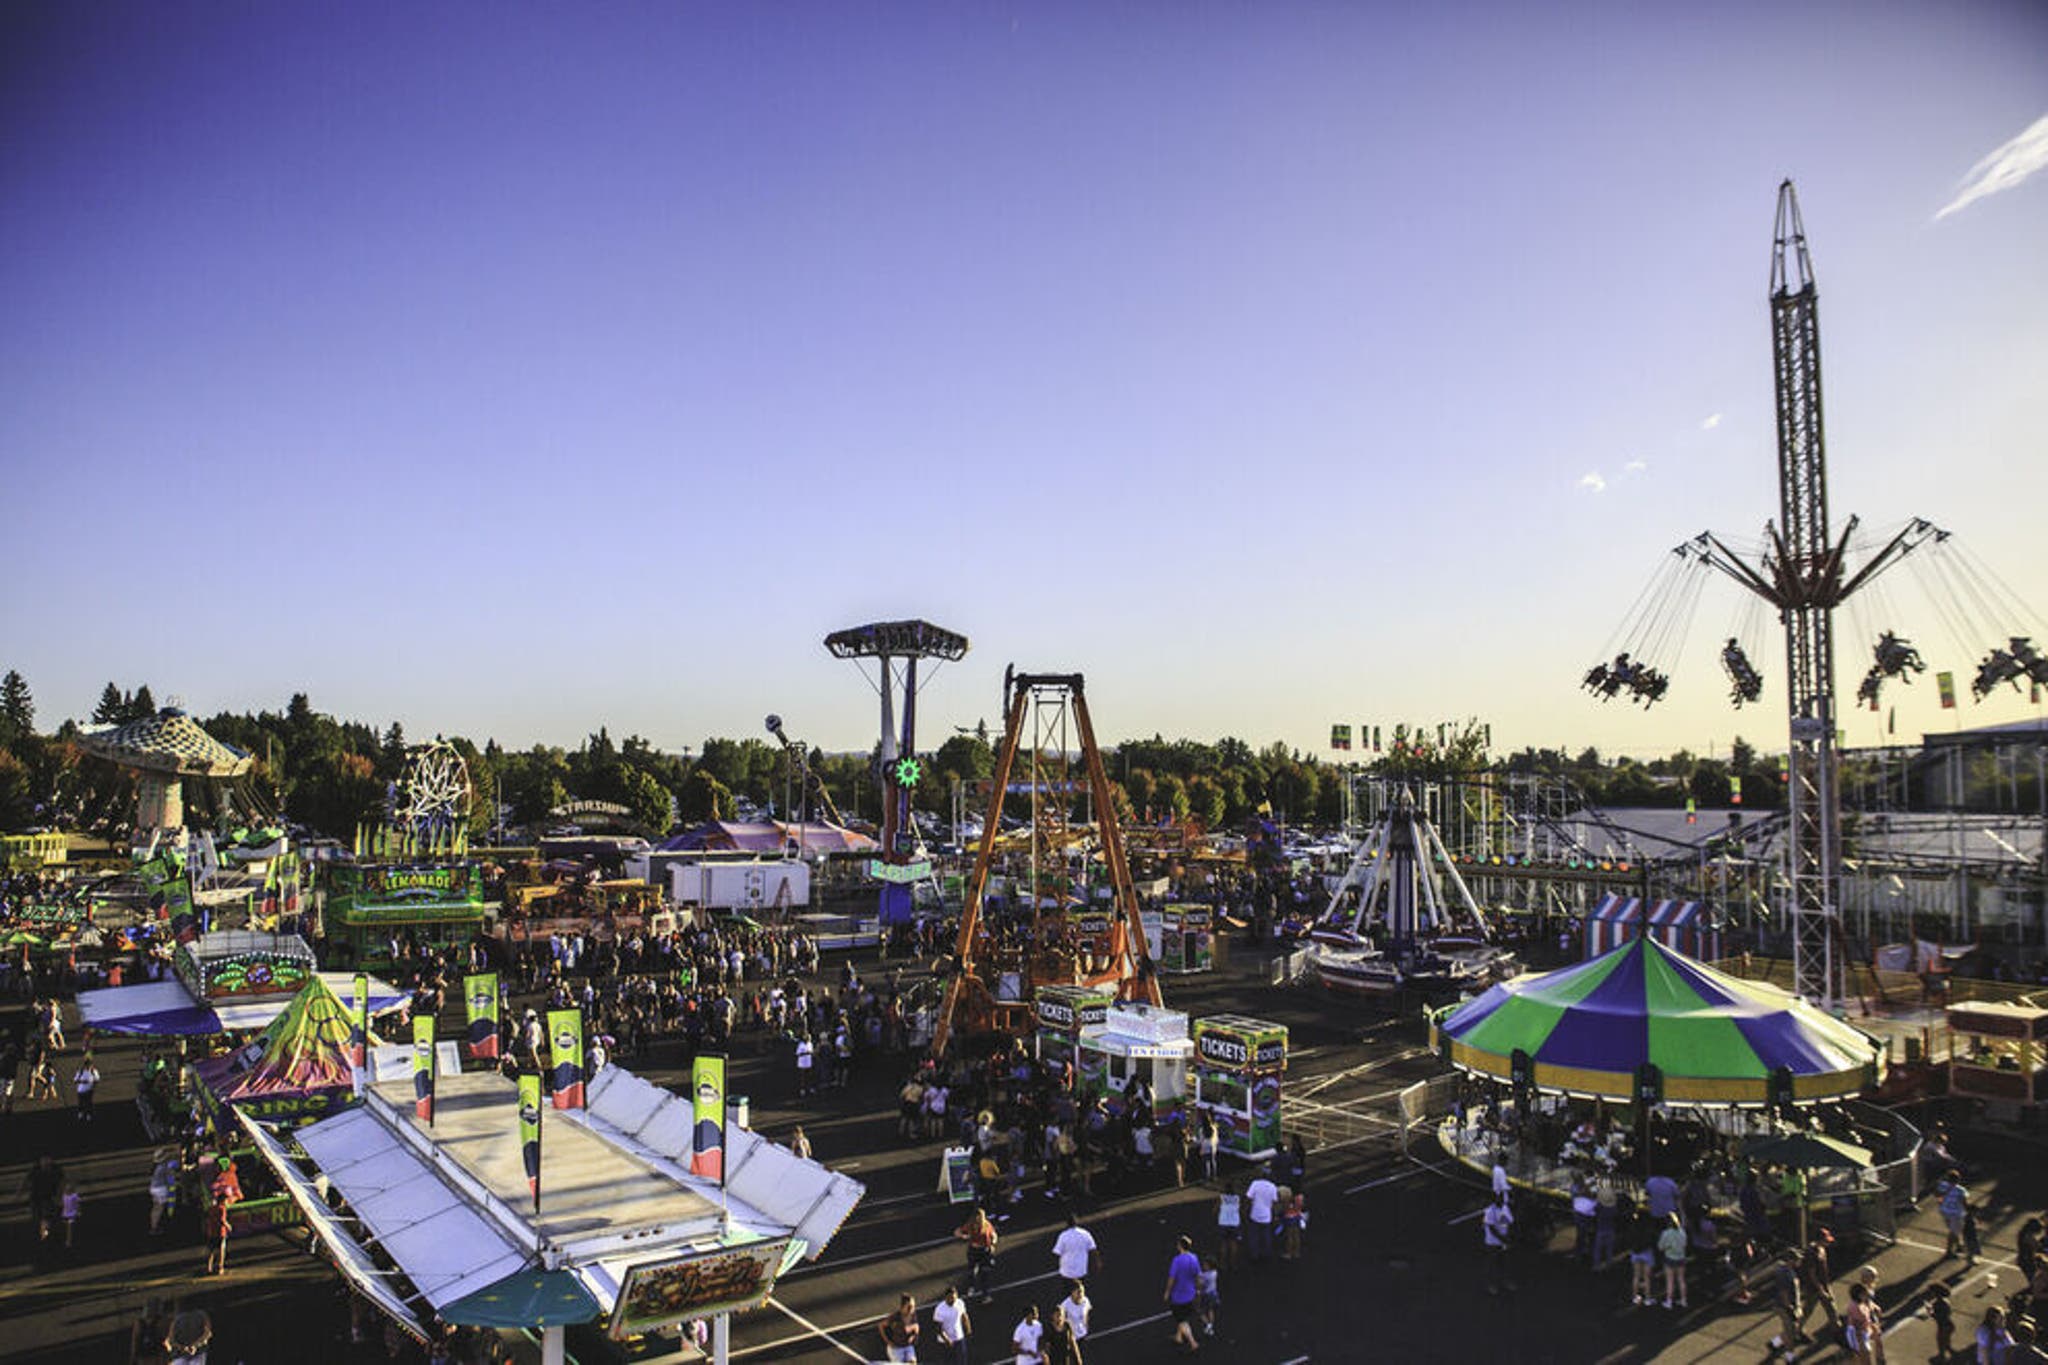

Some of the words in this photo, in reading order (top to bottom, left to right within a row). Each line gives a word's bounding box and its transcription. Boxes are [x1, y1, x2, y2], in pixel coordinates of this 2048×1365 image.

[385, 875, 450, 890] LEMONADE
[1038, 1000, 1073, 1023] TICKETS
[1200, 1036, 1247, 1062] TICKETS
